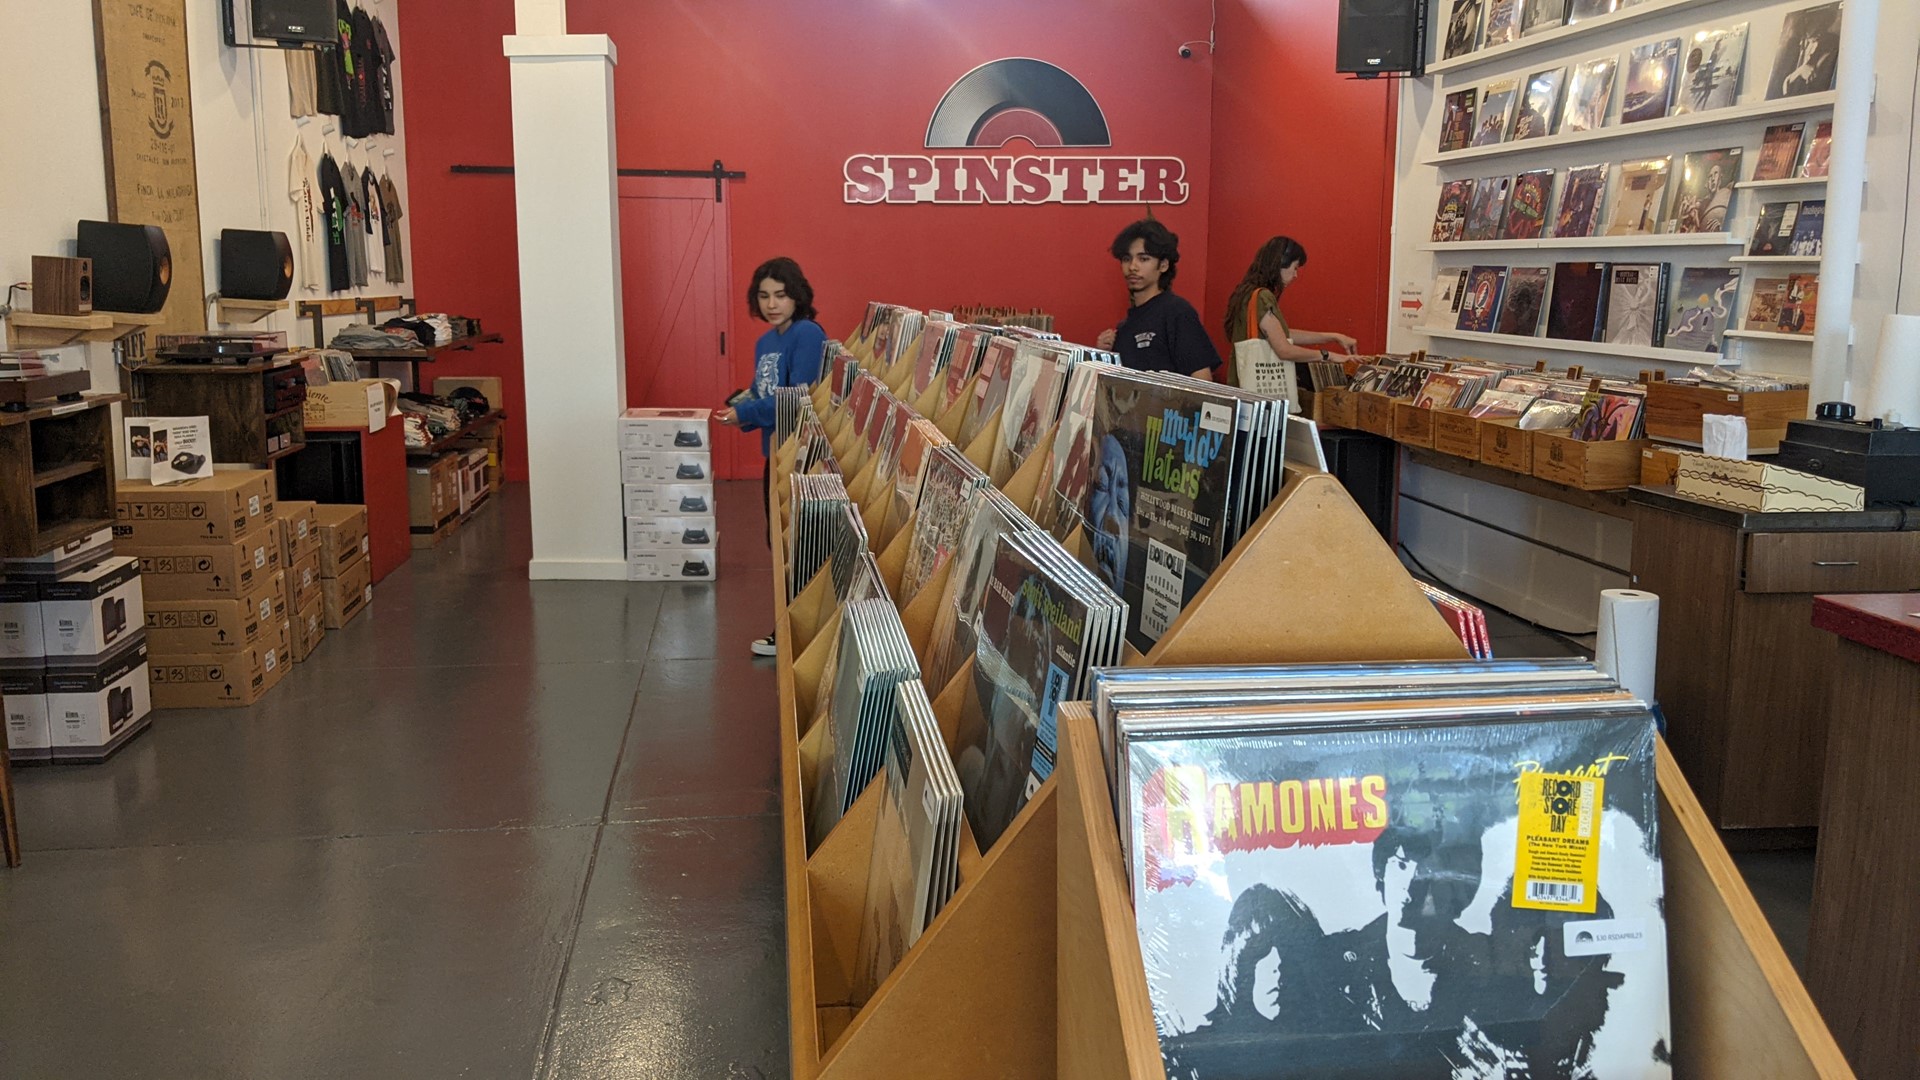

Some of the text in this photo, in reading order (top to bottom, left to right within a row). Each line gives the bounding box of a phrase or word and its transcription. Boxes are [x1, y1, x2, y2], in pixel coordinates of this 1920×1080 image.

[843, 154, 1190, 205] SPINSTER
[1142, 416, 1201, 500] Waters
[1179, 525, 1190, 539] July
[1198, 533, 1212, 546] 1971
[1044, 597, 1082, 646] weiland
[1542, 778, 1581, 798] RECORD
[1543, 797, 1578, 816] STORE
[1148, 764, 1389, 872] RAMONES
[1550, 816, 1567, 833] DAY
[1526, 834, 1590, 846] PLEASANT DREAMS
